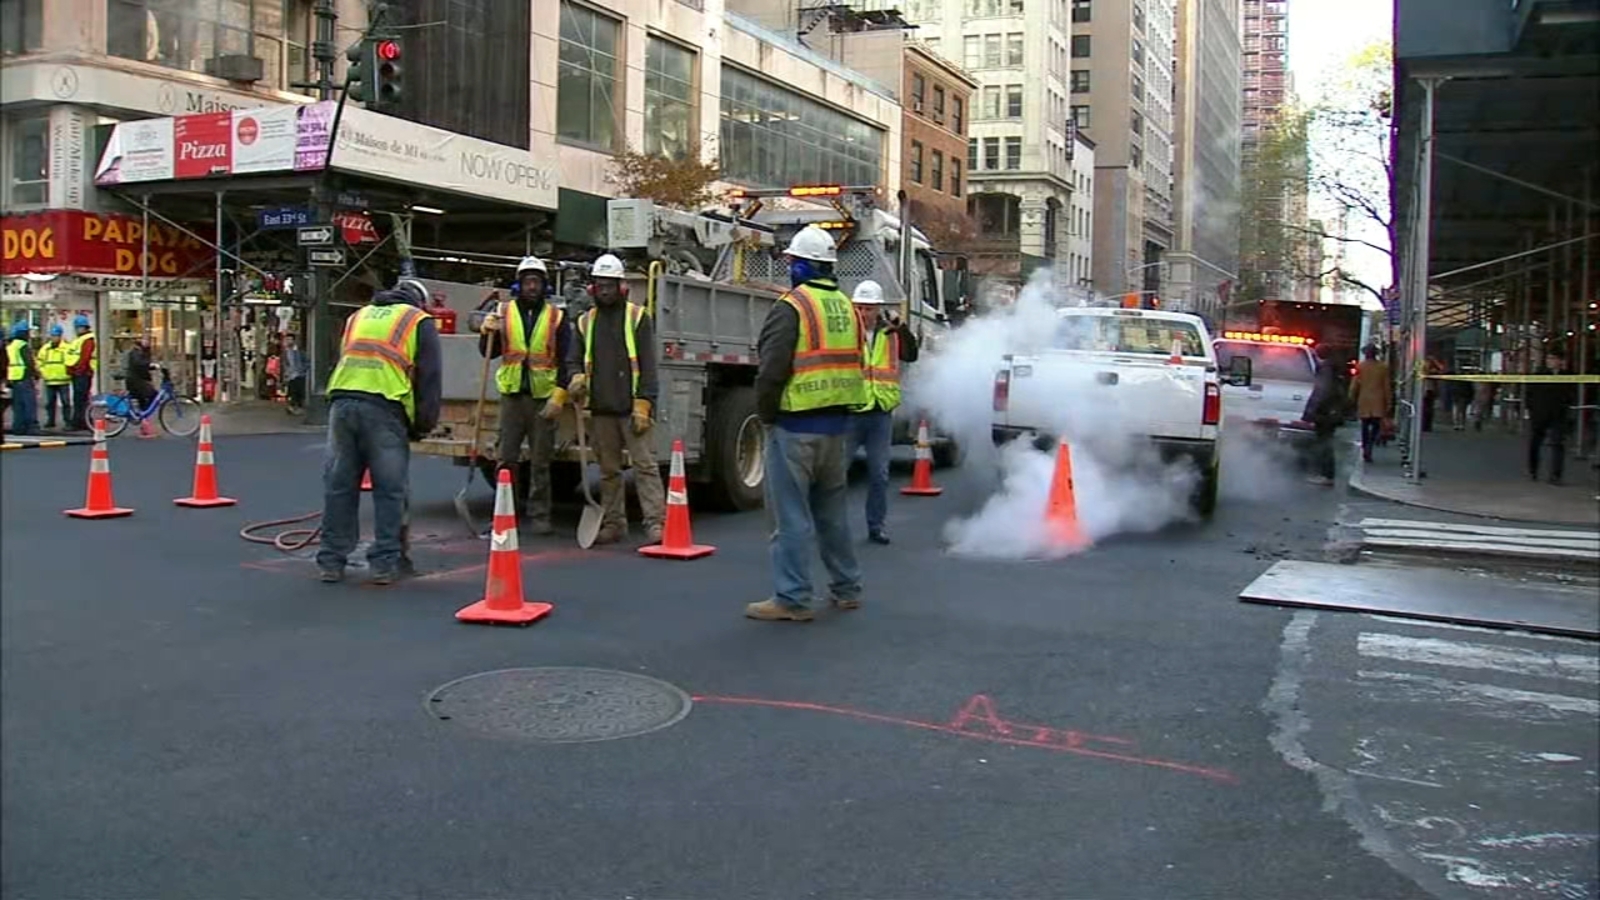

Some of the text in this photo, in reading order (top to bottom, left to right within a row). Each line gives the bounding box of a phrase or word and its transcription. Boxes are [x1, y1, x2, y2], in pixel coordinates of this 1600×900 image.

[186, 91, 247, 114] Mais
[180, 140, 227, 161] Pizza
[461, 152, 502, 180] NOW
[4, 227, 55, 260] DOG
[115, 249, 178, 273] DOG
[101, 278, 131, 288] EGGS
